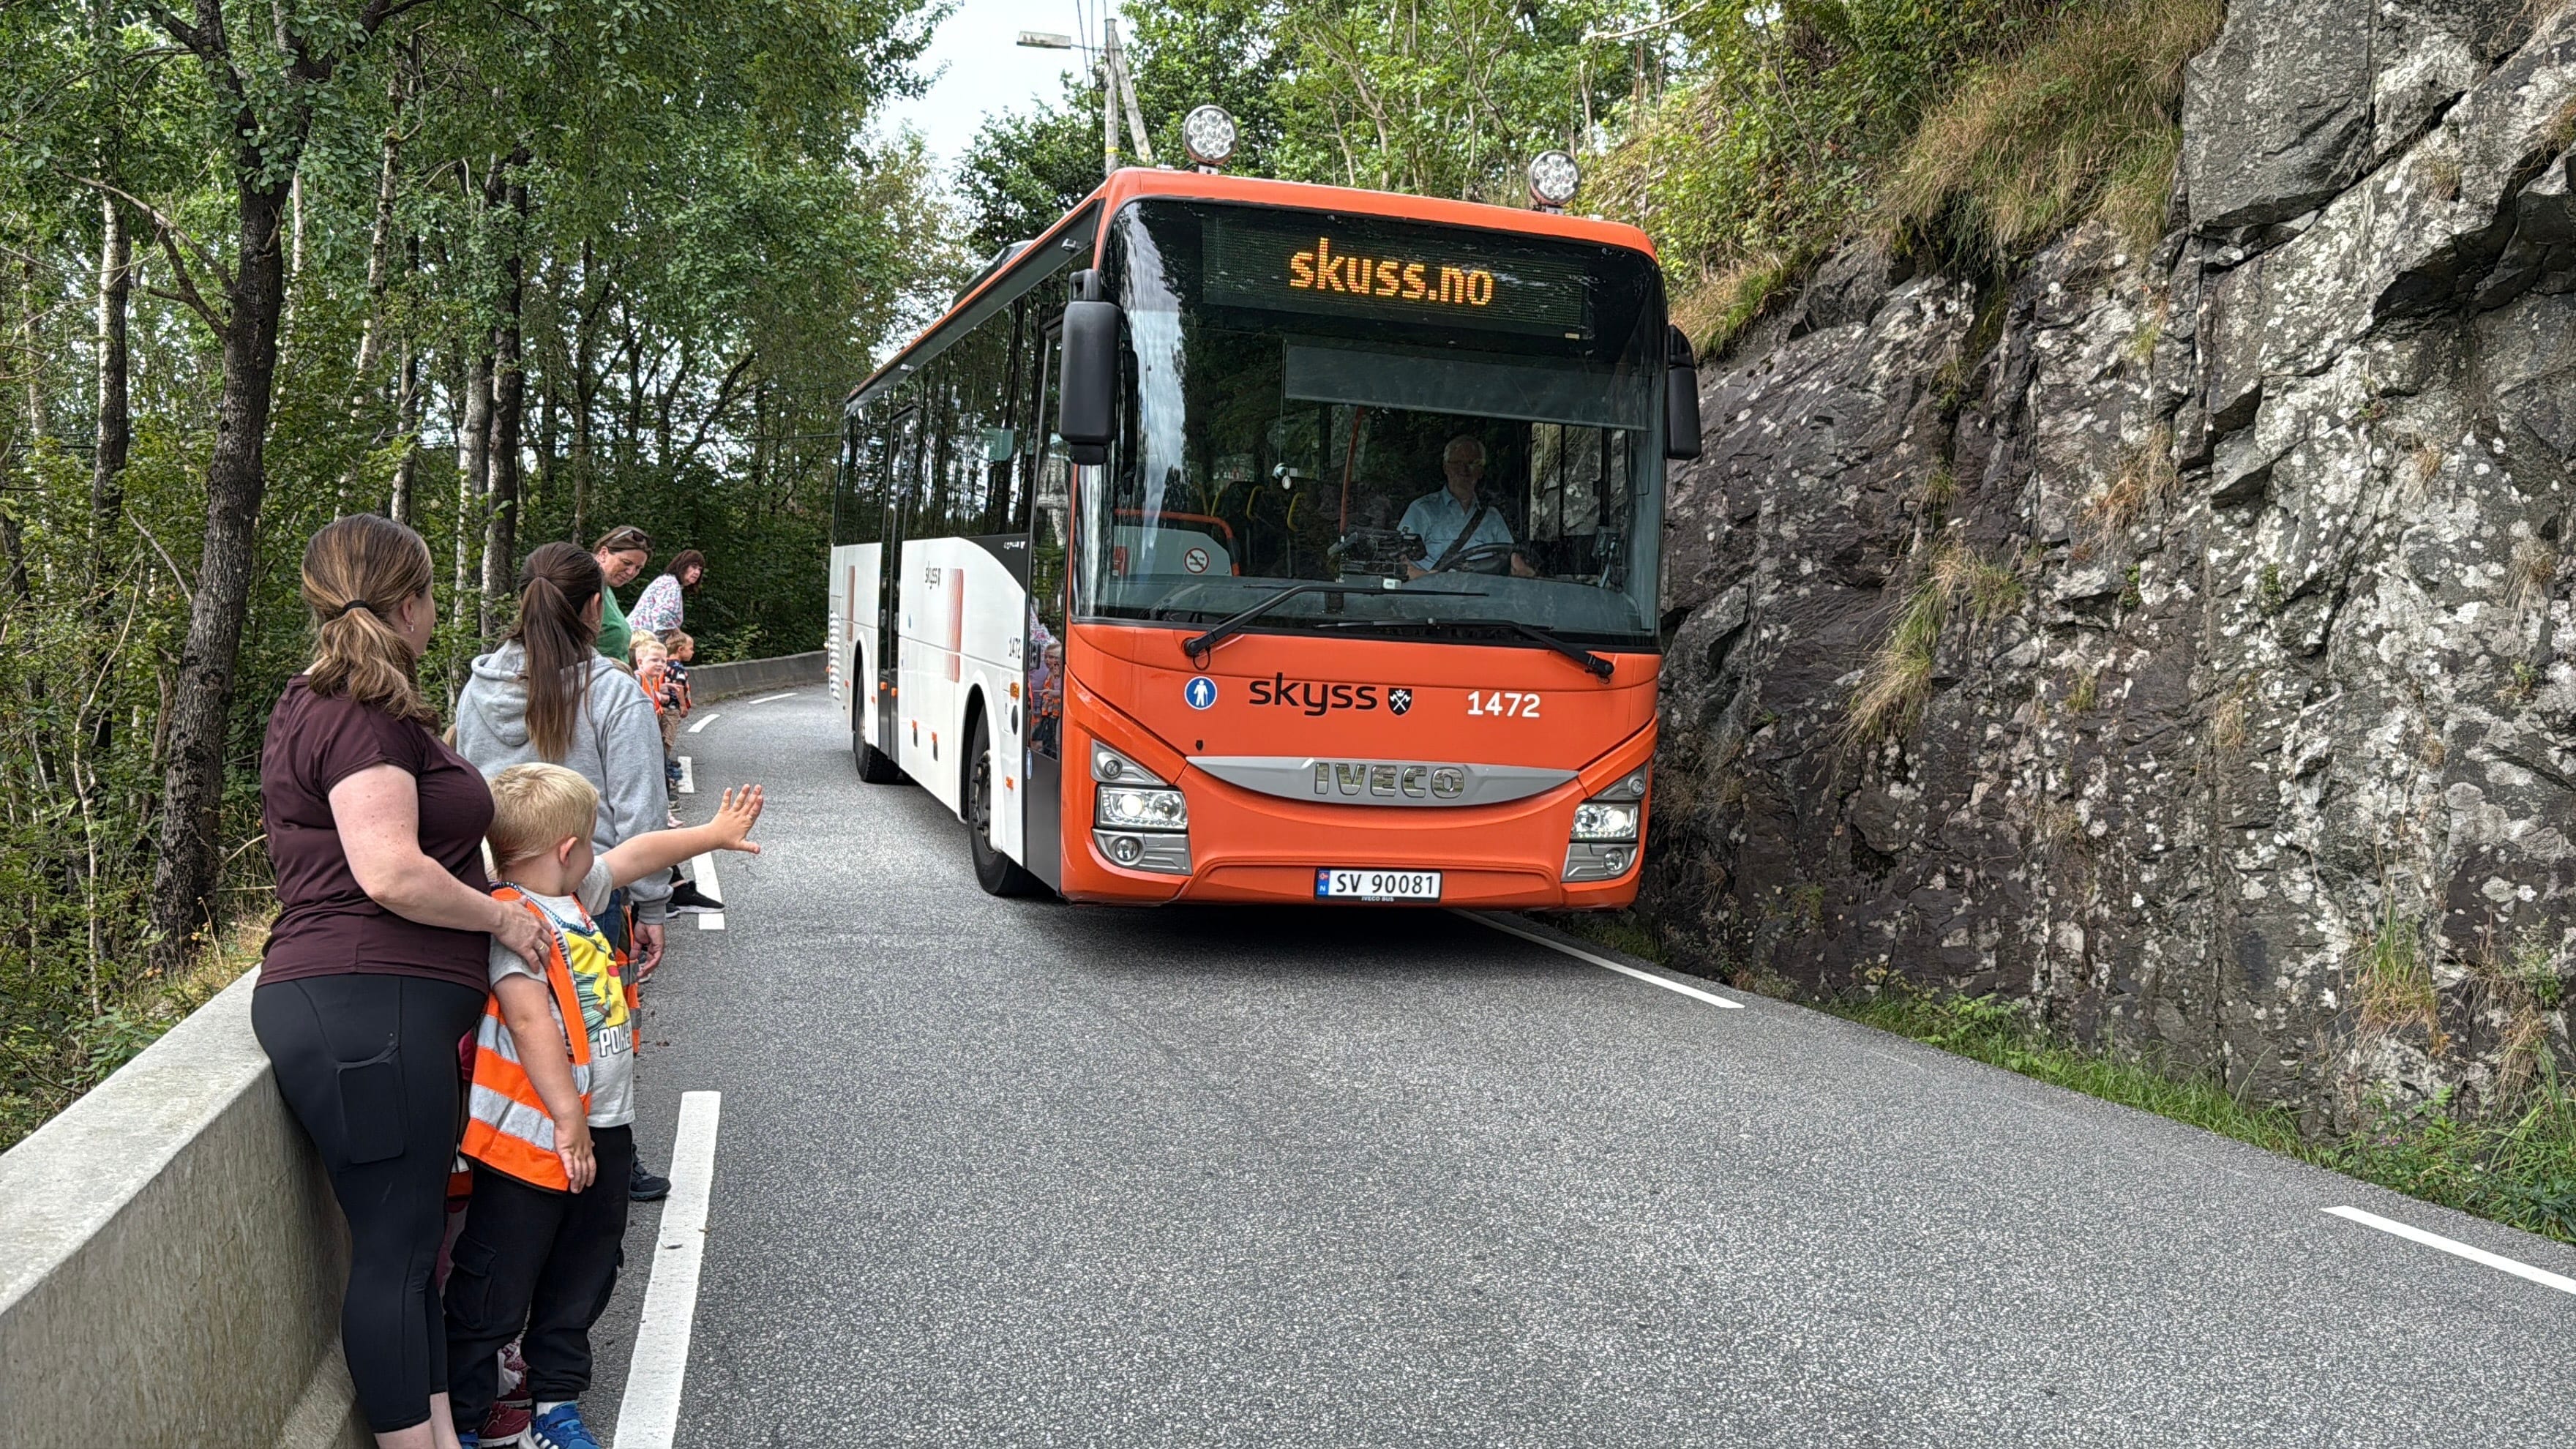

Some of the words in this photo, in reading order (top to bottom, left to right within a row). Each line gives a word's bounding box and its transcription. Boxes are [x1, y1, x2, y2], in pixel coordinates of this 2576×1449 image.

[1290, 237, 1493, 305] skuss.no
[1248, 672, 1377, 716] skyss
[1467, 690, 1540, 718] 1472
[1314, 762, 1464, 799] IVECO
[1336, 873, 1362, 893] SV
[1371, 874, 1434, 895] 90081
